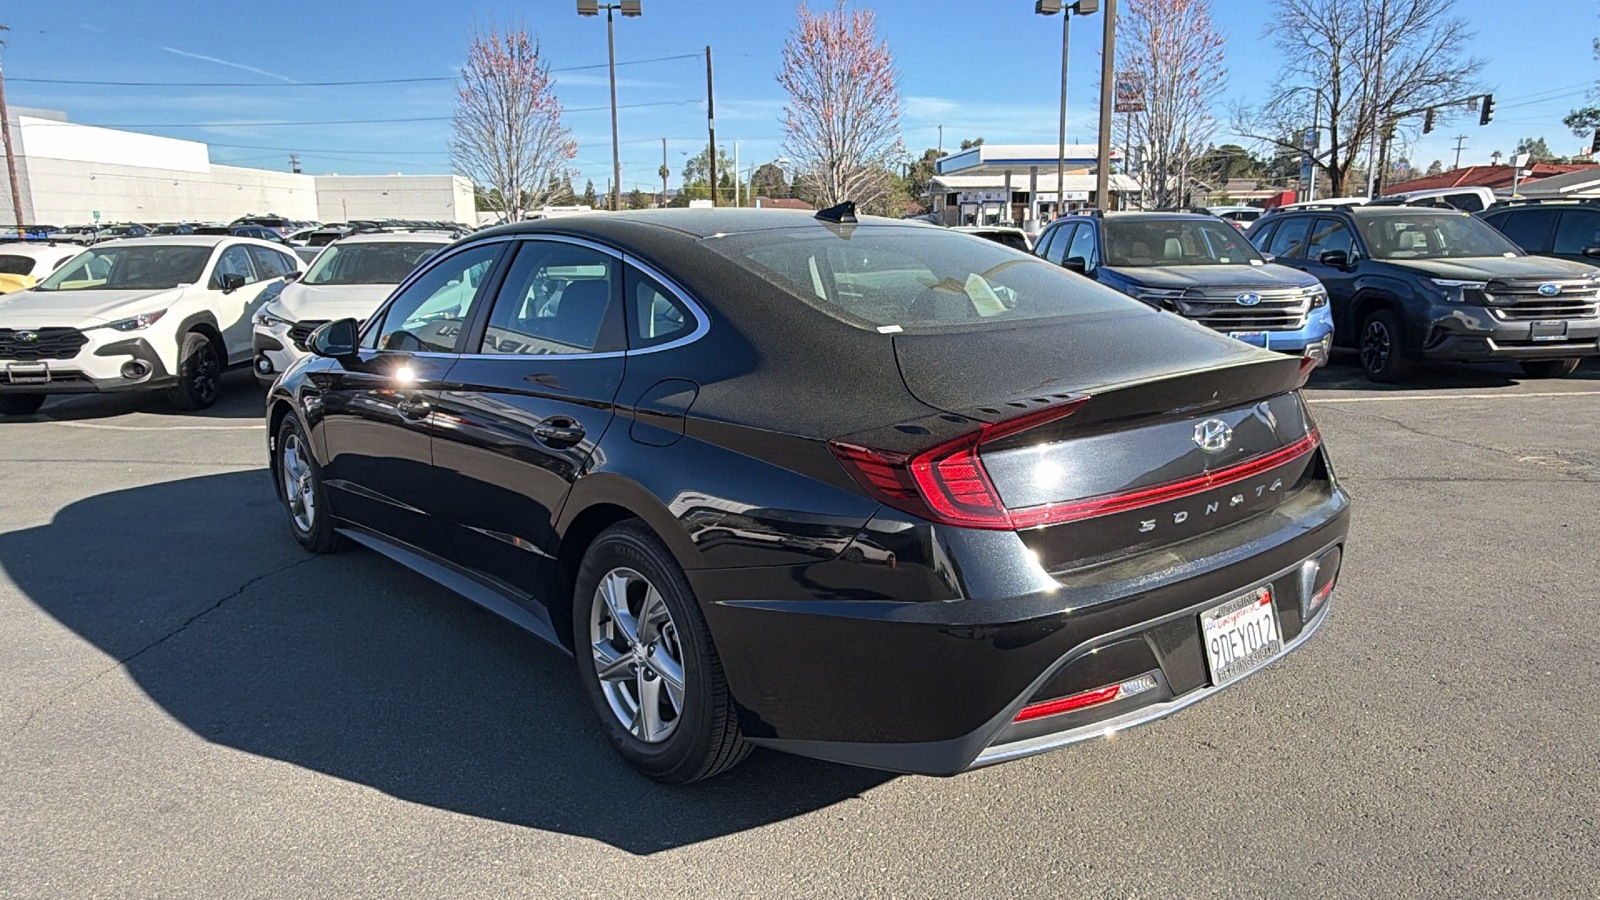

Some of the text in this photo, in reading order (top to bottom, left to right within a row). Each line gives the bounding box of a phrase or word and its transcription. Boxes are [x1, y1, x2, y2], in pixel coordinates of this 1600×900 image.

[1138, 478, 1282, 533] SONATA
[1211, 614, 1277, 671] 9DEY012
[1251, 641, 1280, 665] SUBARU
